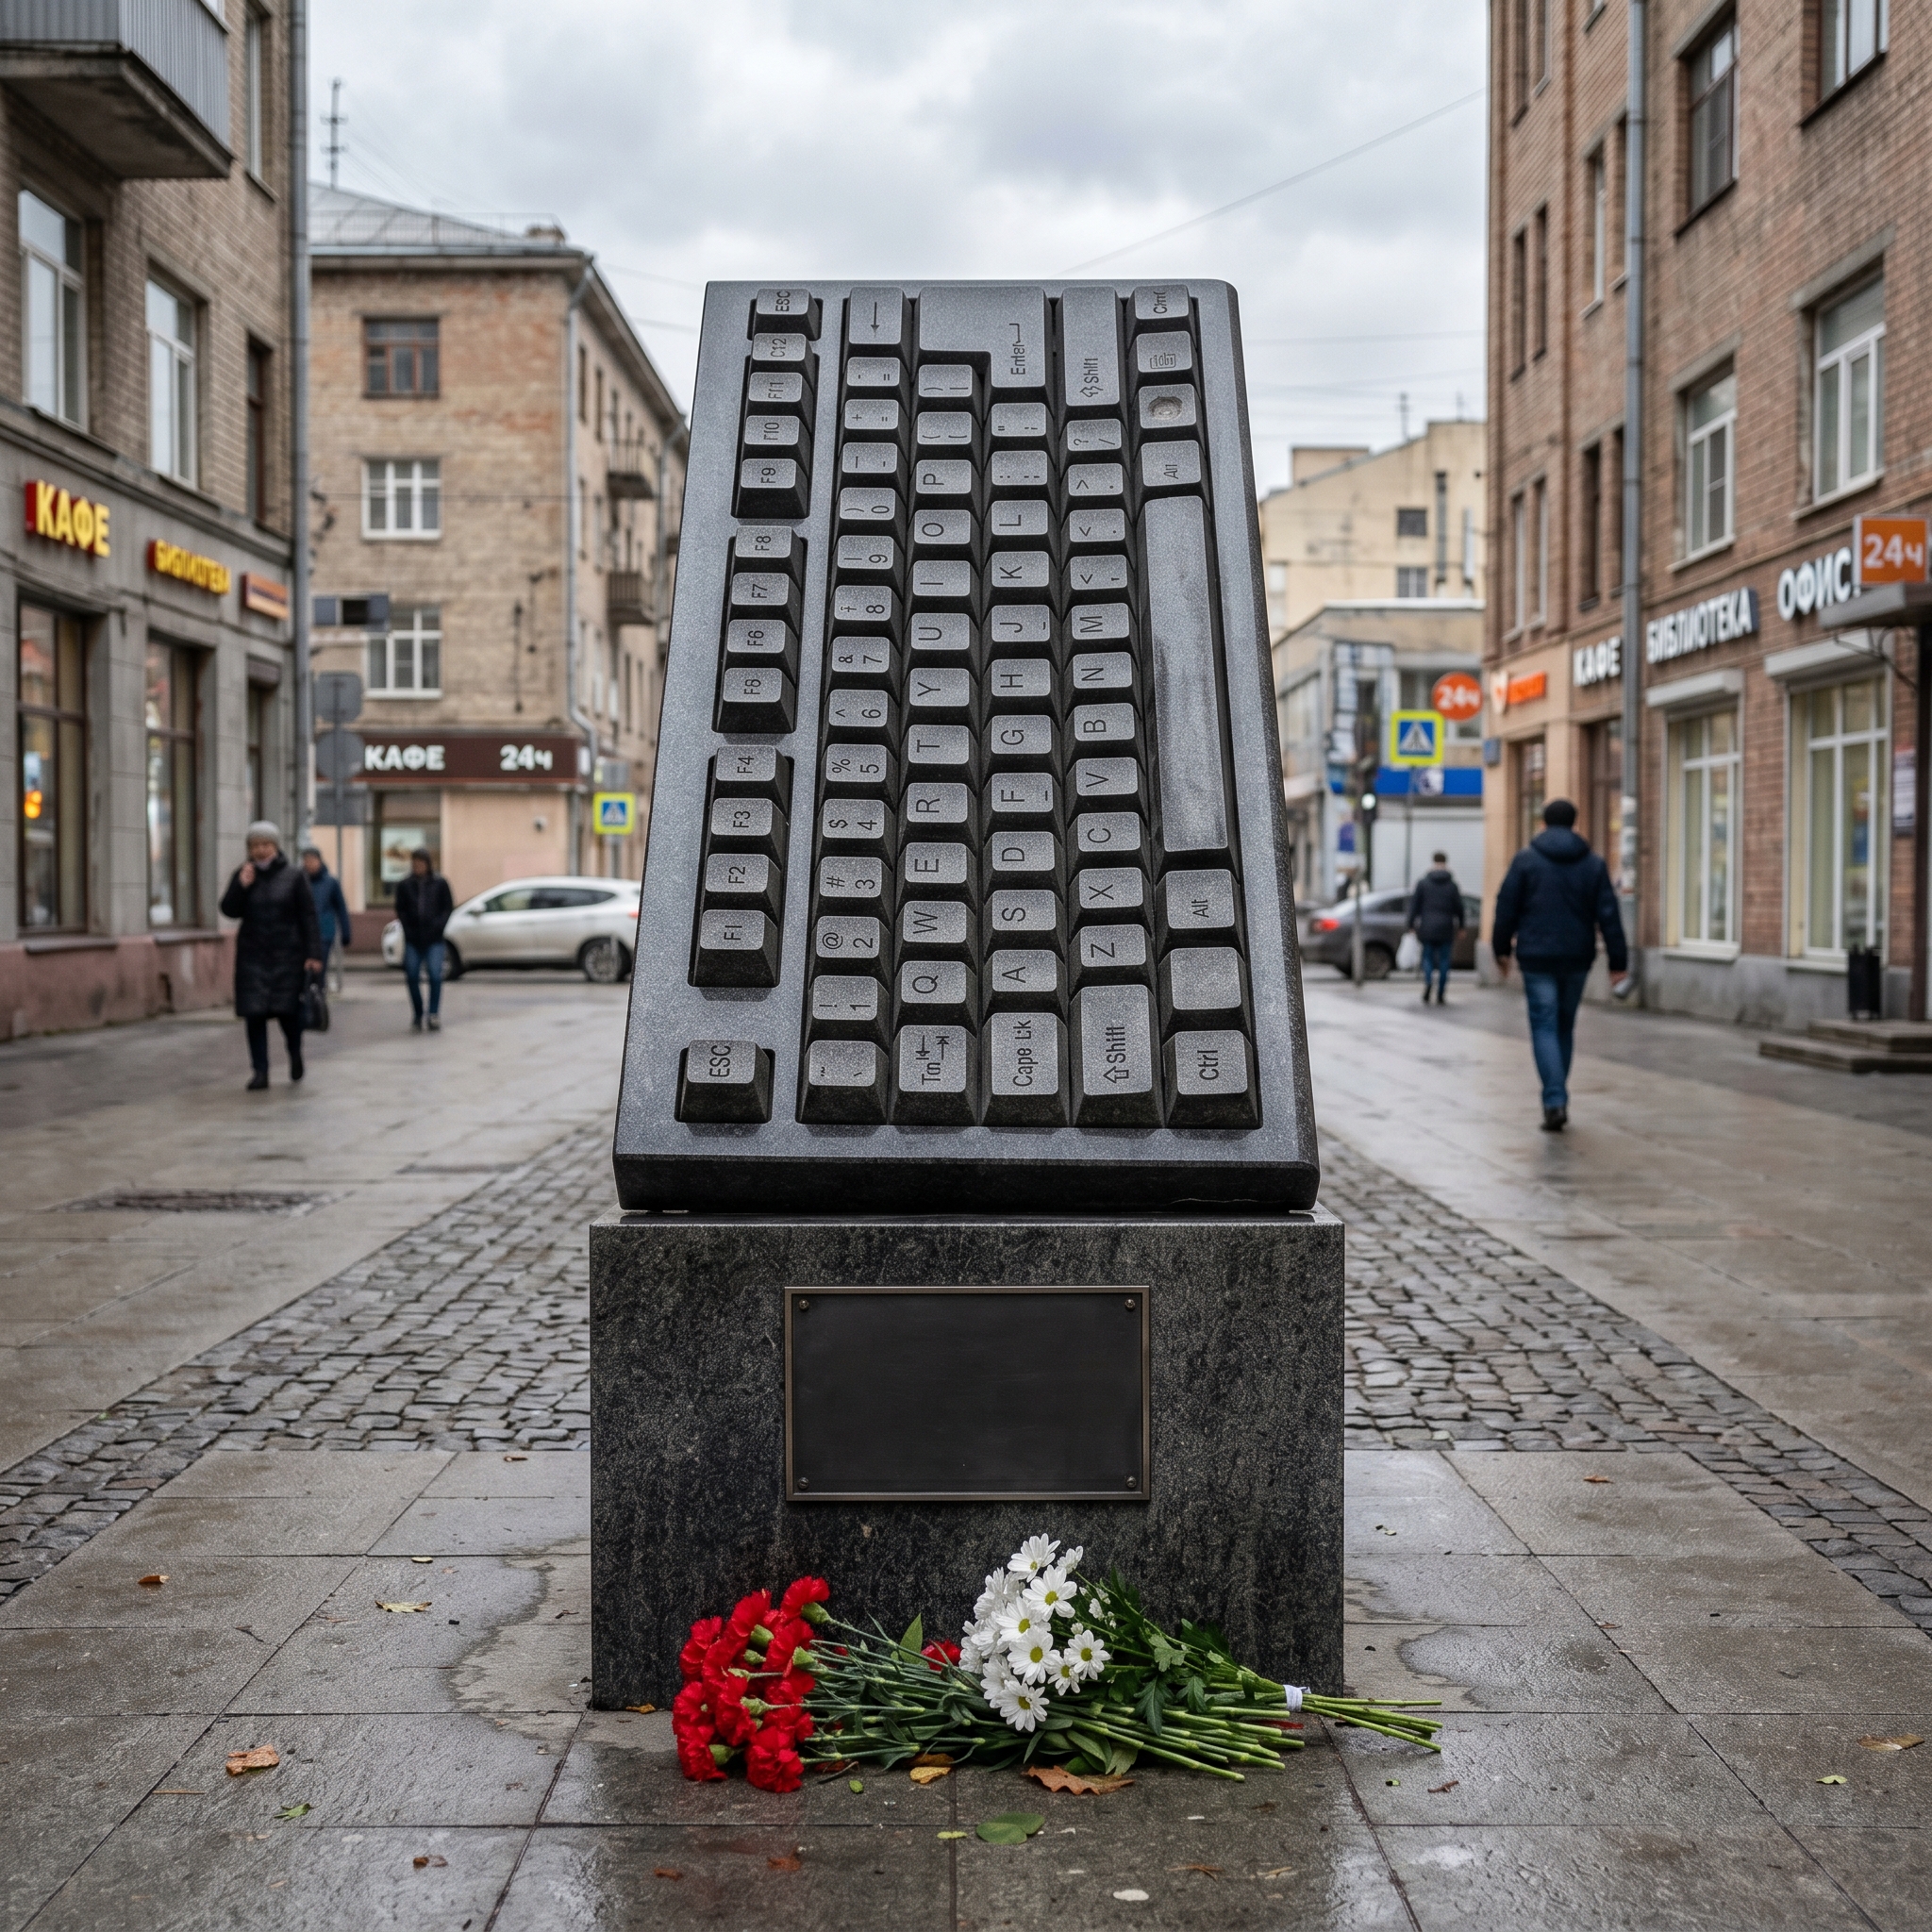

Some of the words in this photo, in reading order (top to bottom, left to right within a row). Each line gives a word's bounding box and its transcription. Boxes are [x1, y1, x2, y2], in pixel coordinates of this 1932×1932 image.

[774, 289, 791, 312] ESC
[760, 467, 776, 484] F9
[922, 473, 944, 486] P
[871, 505, 891, 514] 0
[36, 478, 110, 558] КАФЕ
[998, 514, 1022, 527] L
[921, 522, 944, 538] O
[755, 535, 772, 551] F8
[1862, 533, 1924, 569] 24ч
[868, 554, 889, 564] 9
[999, 565, 1023, 579] K
[751, 583, 768, 599] F7
[865, 604, 886, 614] 8
[999, 622, 1024, 634] J
[1079, 615, 1104, 633] M
[1646, 586, 1753, 664] БИБЛИОТЕКА
[746, 629, 765, 646] F6
[918, 626, 942, 641] U
[862, 654, 883, 664] 7
[1574, 636, 1622, 687] КАФЕ
[999, 674, 1024, 689] H
[1080, 667, 1105, 682] N
[917, 681, 941, 697] Y
[860, 708, 882, 719] 6
[1083, 719, 1107, 734] B
[1000, 729, 1024, 746] G
[916, 739, 941, 754] T
[364, 744, 445, 771] КАФЕ
[737, 755, 755, 774] F4
[831, 758, 851, 774] %
[859, 763, 880, 774] 5
[1085, 772, 1109, 788] V
[1000, 789, 1025, 803] F
[915, 797, 941, 813] R
[732, 810, 751, 828] F3
[827, 819, 849, 829] $
[857, 819, 877, 831] 4
[1087, 827, 1112, 844] C
[1001, 846, 1025, 862] D
[914, 858, 940, 874] E
[727, 866, 746, 884] F2
[825, 875, 845, 889] #
[855, 878, 875, 890] 3
[1088, 884, 1114, 901] X
[1001, 907, 1026, 923] S
[1191, 899, 1209, 919] Alt
[912, 910, 939, 935] W
[822, 931, 843, 950] @
[852, 937, 874, 949] 2
[1090, 941, 1116, 958] Z
[1001, 966, 1026, 984] A
[911, 974, 940, 994] Q
[708, 1042, 733, 1077] ESC
[1196, 1049, 1220, 1081] Ctrl
